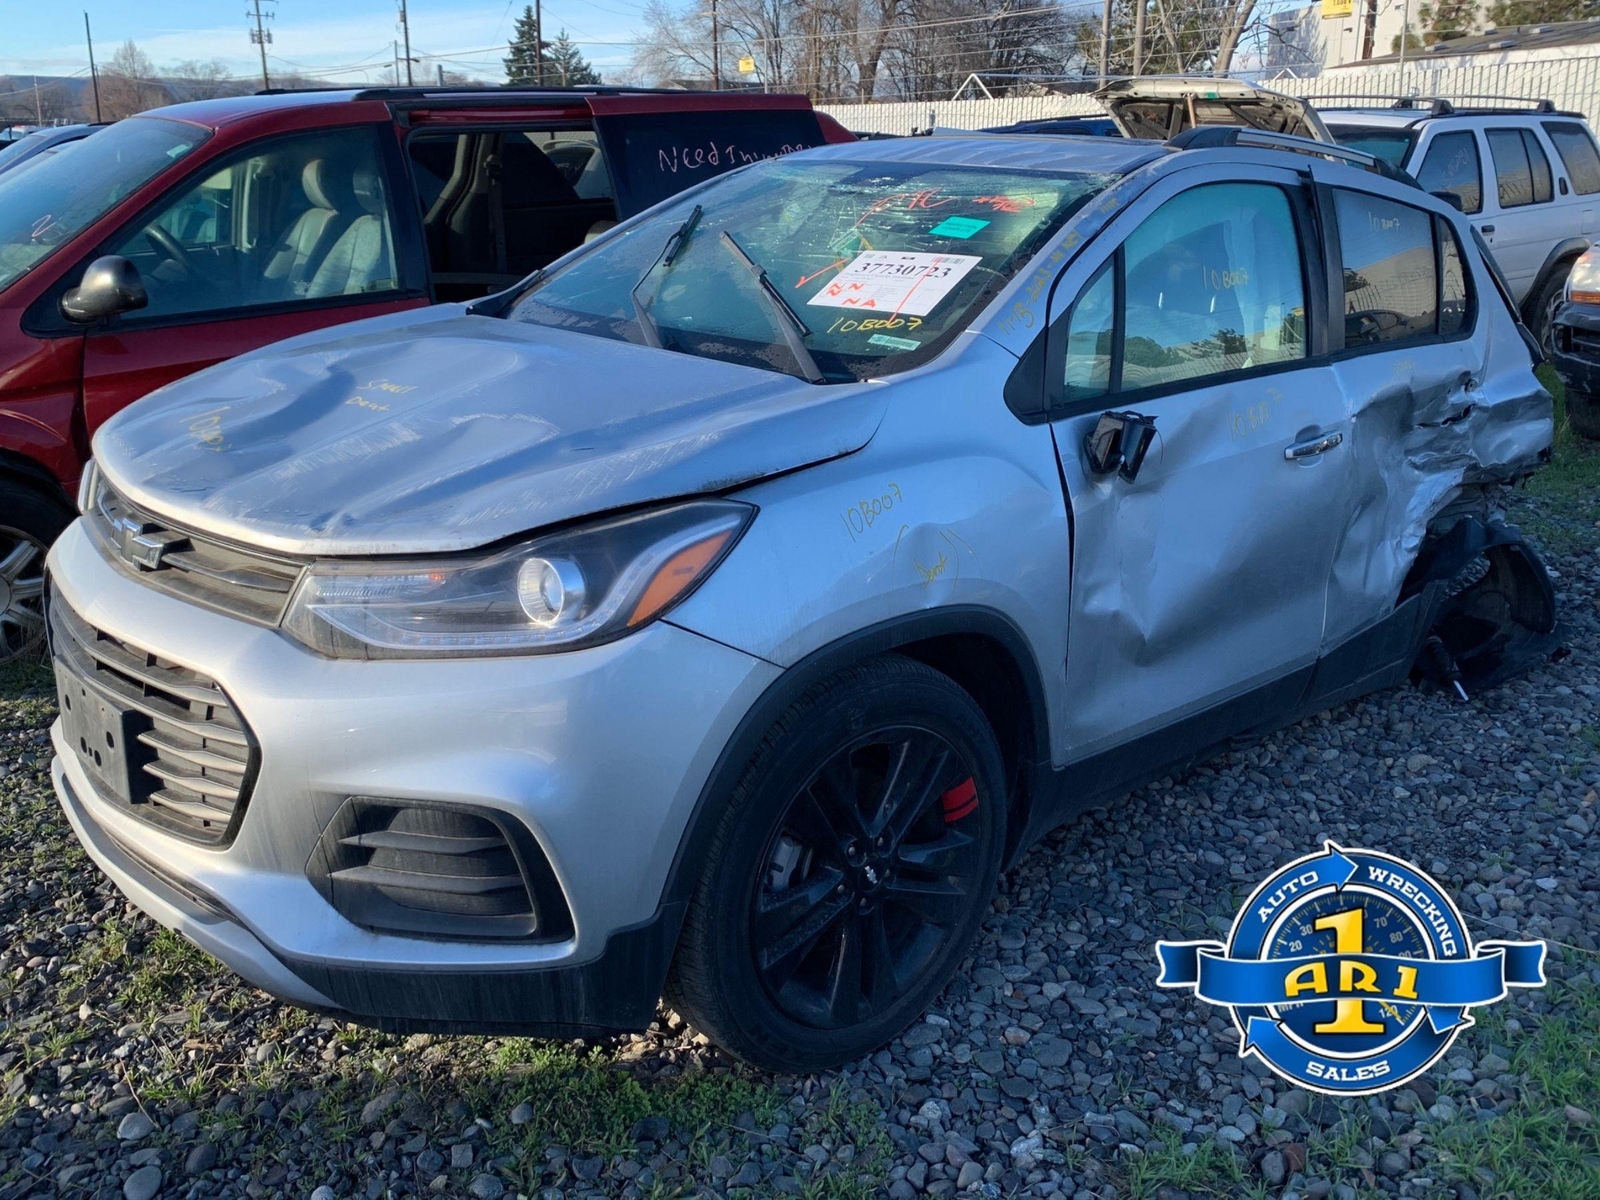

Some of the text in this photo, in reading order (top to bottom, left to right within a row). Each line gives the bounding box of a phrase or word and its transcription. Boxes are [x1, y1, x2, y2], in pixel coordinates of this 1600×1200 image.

[855, 262, 952, 279] 37730723
[827, 316, 923, 334] 10B007
[839, 482, 903, 543] 10B007
